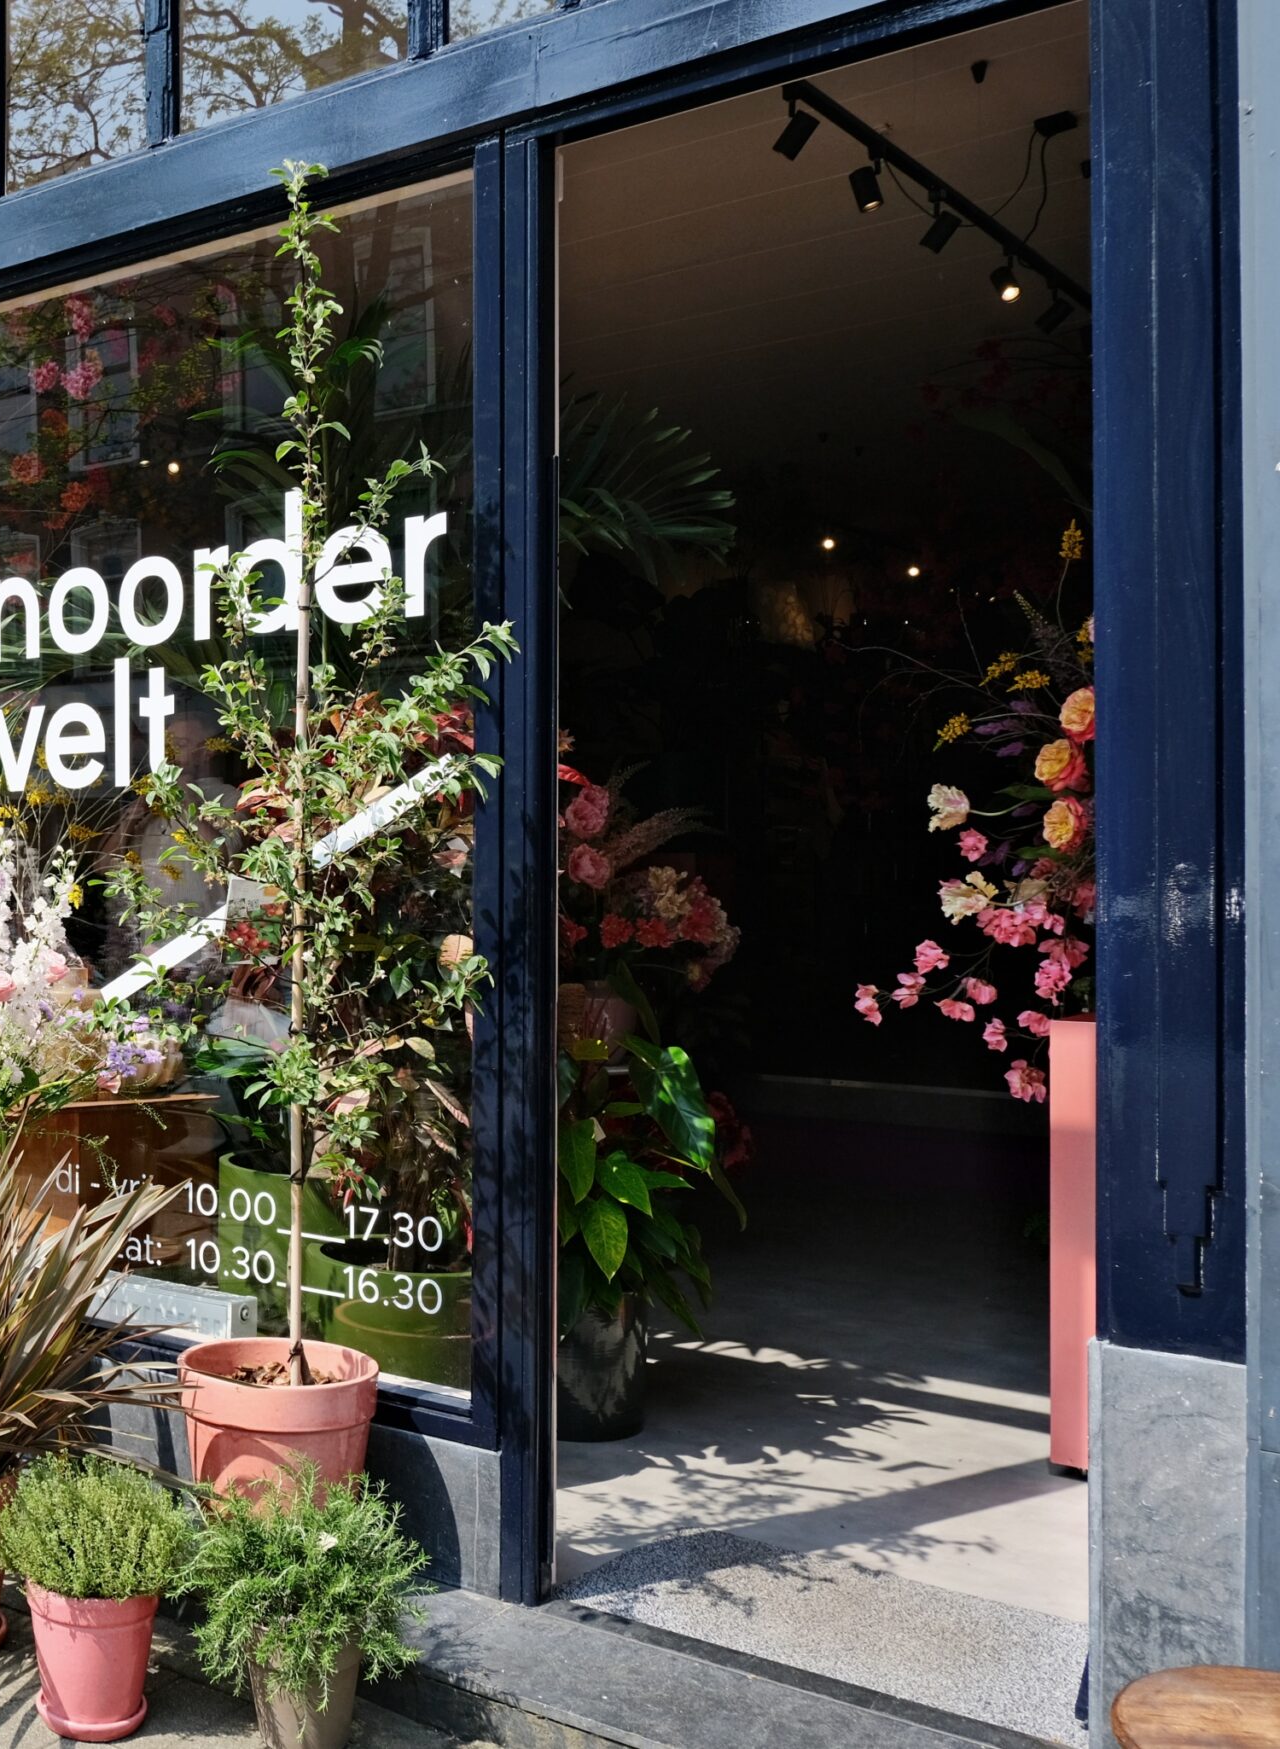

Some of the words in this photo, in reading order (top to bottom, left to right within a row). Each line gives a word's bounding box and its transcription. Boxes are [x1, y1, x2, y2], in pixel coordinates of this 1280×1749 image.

[55, 1163, 80, 1195] di
[184, 1182, 277, 1226] 10.00
[344, 1204, 443, 1252] 17.30
[117, 1234, 163, 1267] at:
[186, 1238, 276, 1284] 10.30
[343, 1266, 442, 1315] 16.30
